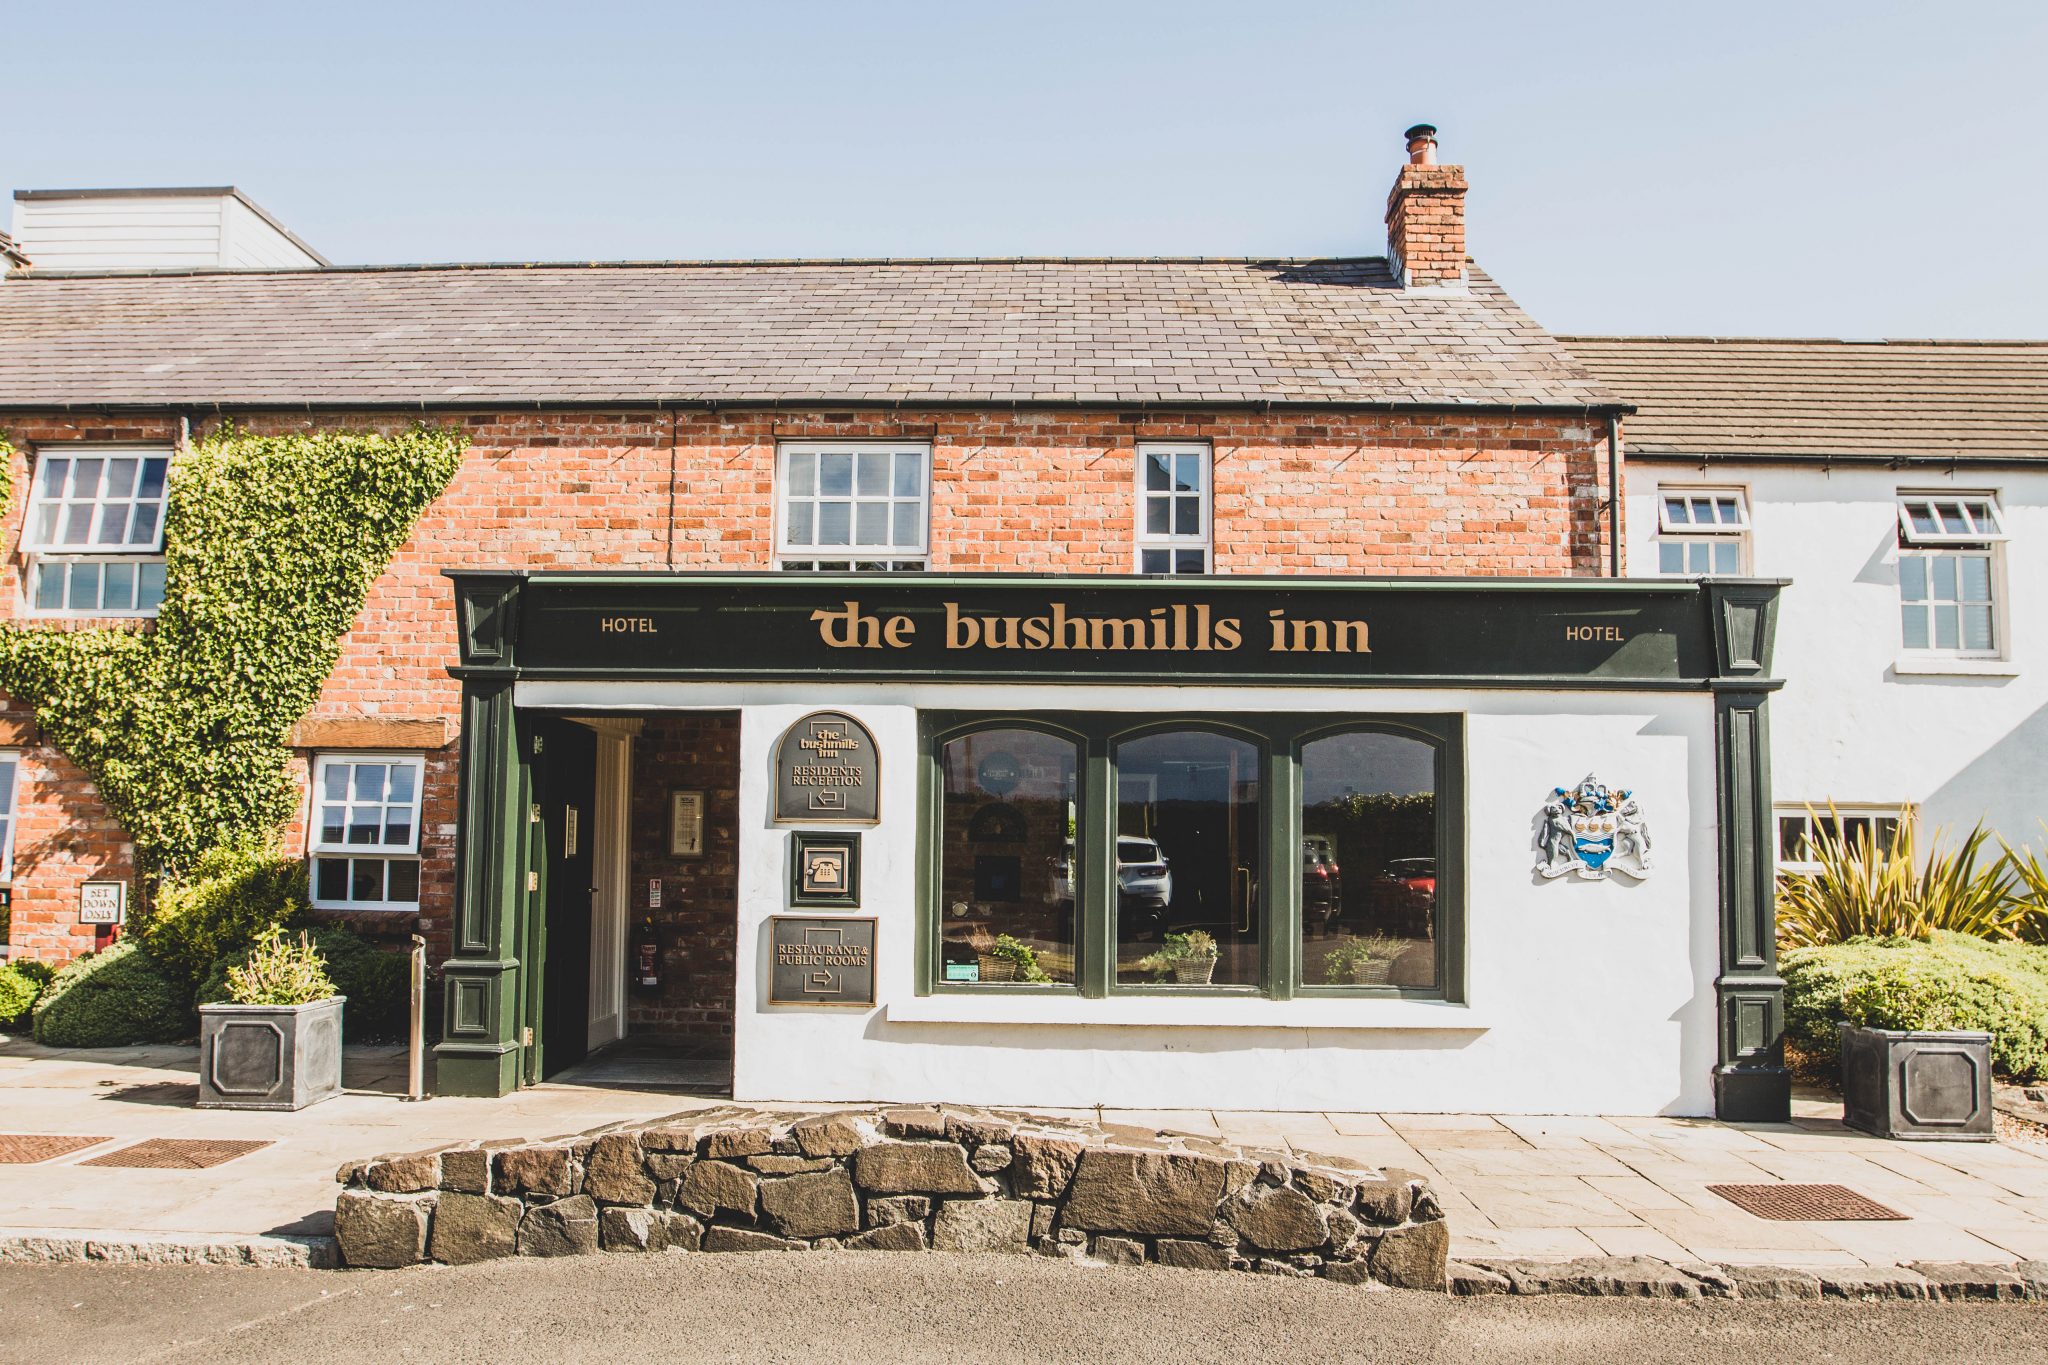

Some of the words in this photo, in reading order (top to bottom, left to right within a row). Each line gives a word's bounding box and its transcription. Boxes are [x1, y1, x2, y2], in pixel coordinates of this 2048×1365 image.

[602, 617, 658, 633] HOTEL
[810, 601, 916, 649] the
[943, 602, 1243, 651] bushmills
[1268, 609, 1373, 653] inn
[1566, 625, 1625, 641] HOTEL
[818, 730, 839, 739] the
[801, 739, 859, 749] bushmills
[819, 748, 838, 757] inn
[794, 766, 862, 775] RESIDENTS
[793, 776, 862, 785] RECEPTION
[91, 889, 110, 898] SET
[84, 900, 116, 908] DOWN
[85, 910, 112, 919] ONLY
[778, 944, 859, 954] RESTAURANT
[861, 946, 868, 955] &
[778, 955, 821, 964] PUBLIC
[825, 955, 867, 965] ROOMS
